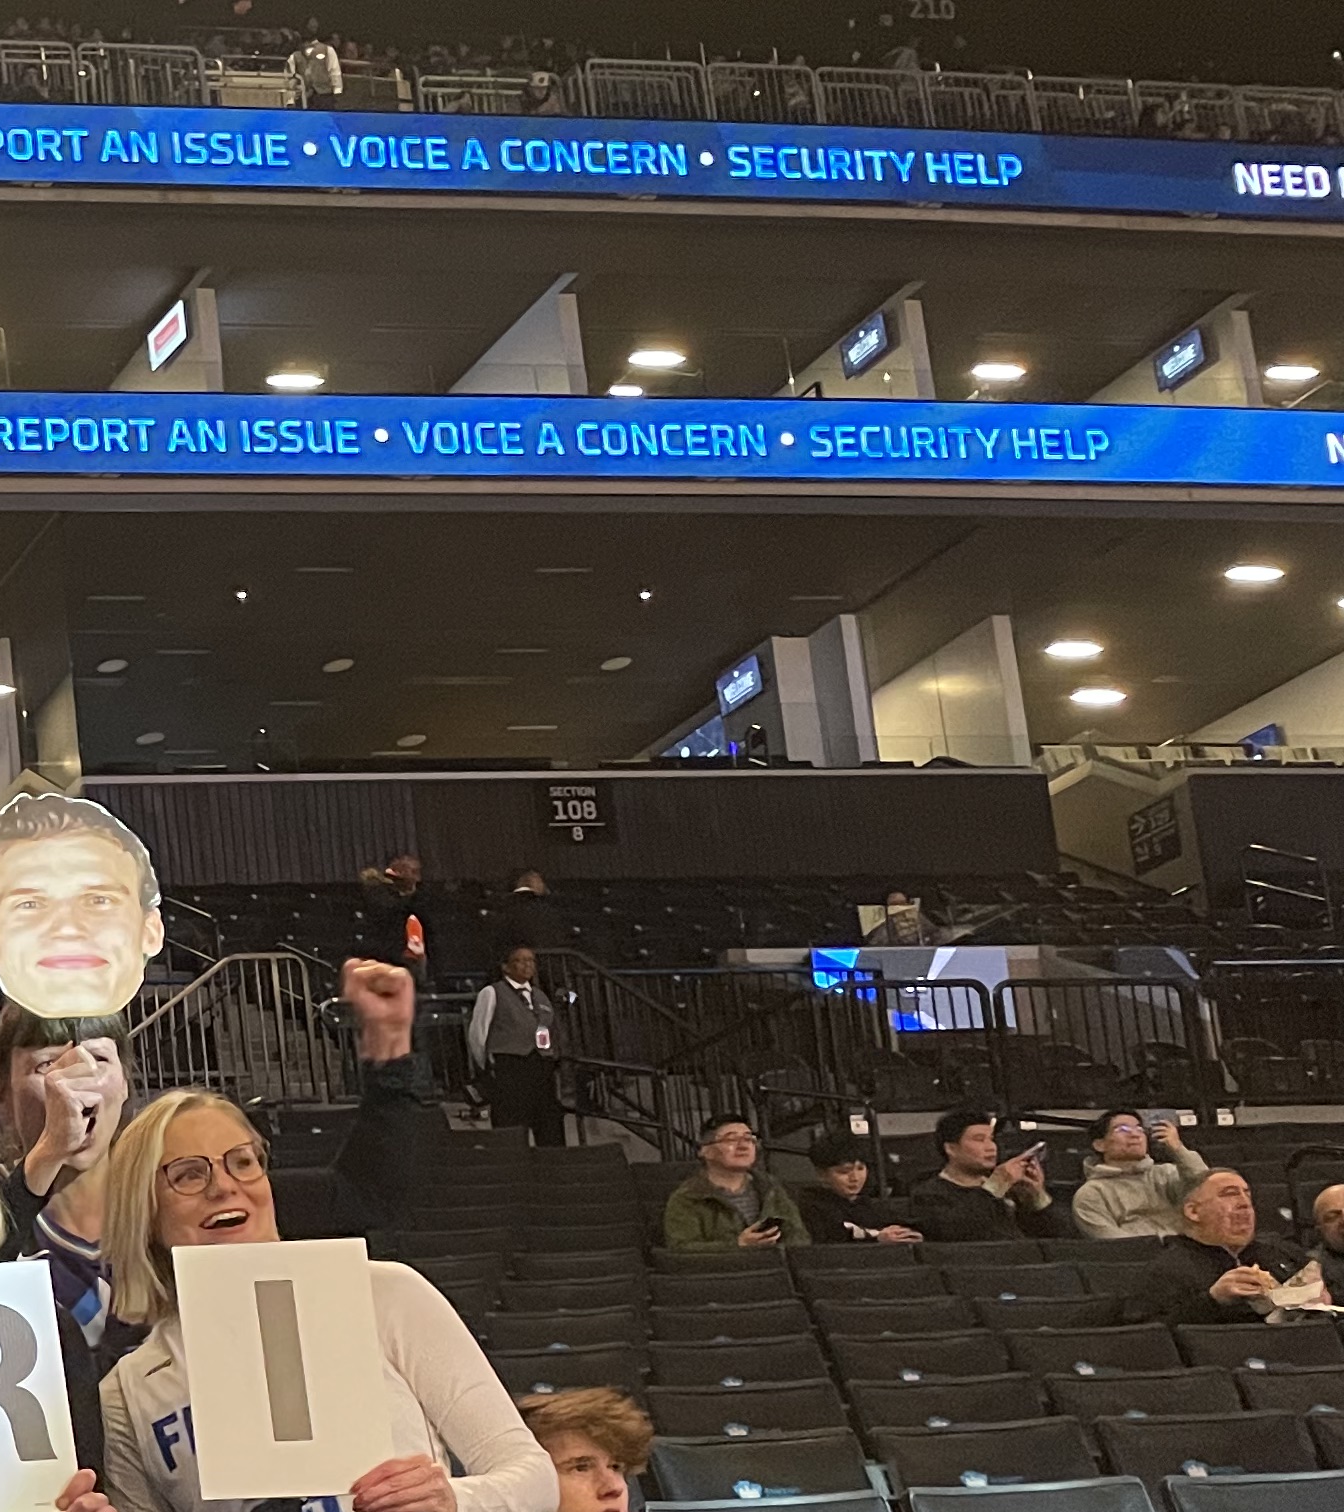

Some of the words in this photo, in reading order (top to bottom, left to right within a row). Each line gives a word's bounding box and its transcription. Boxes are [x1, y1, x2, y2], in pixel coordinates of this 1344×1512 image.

[100, 130, 160, 164] AN
[173, 131, 291, 167] ISSUE
[330, 135, 450, 170] VOICE
[461, 138, 490, 170] A
[500, 139, 688, 176] CONCERN
[728, 145, 915, 184] SECURITY
[925, 152, 1023, 187] HELP
[1233, 162, 1331, 198] NEED
[167, 419, 226, 453] AN
[241, 420, 360, 454] ISSUE
[402, 421, 524, 456] VOICE
[537, 423, 565, 455] A
[576, 423, 767, 457] CONCERN
[811, 425, 999, 459] SECURITY
[1013, 428, 1110, 461] HELP
[549, 786, 596, 797] SECTION
[553, 800, 597, 820] 108
[573, 826, 584, 841] 8
[254, 1280, 313, 1441] I
